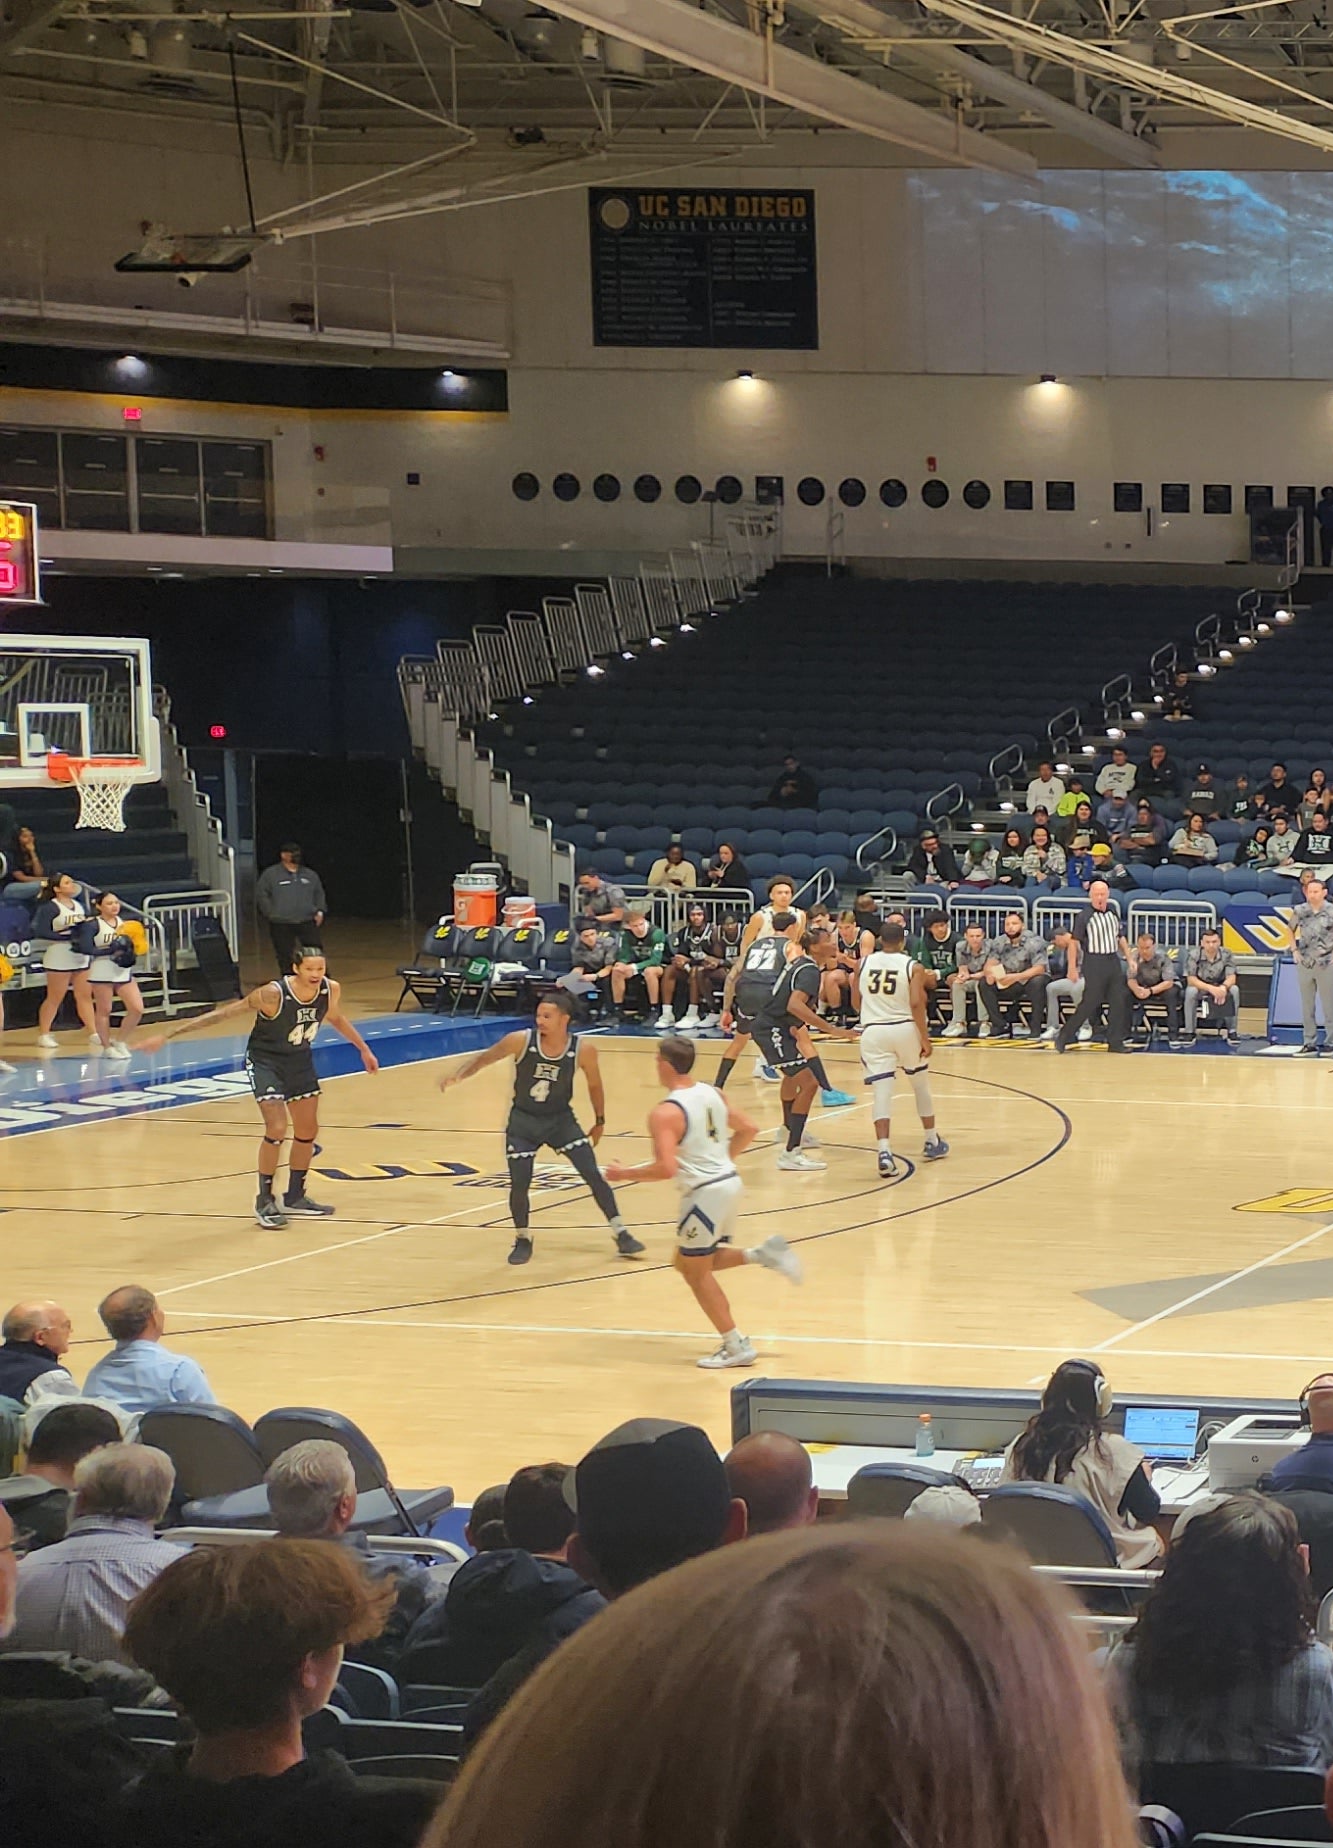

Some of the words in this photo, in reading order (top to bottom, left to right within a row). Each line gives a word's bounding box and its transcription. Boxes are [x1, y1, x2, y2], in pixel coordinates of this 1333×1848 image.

[638, 195, 670, 217] UC
[677, 196, 727, 217] SAN
[735, 196, 807, 218] DIEGO
[638, 220, 698, 232] NOBEL
[708, 221, 808, 232] LAUREATES
[868, 969, 899, 995] 35
[287, 1021, 320, 1046] 44
[529, 1080, 550, 1102] 4
